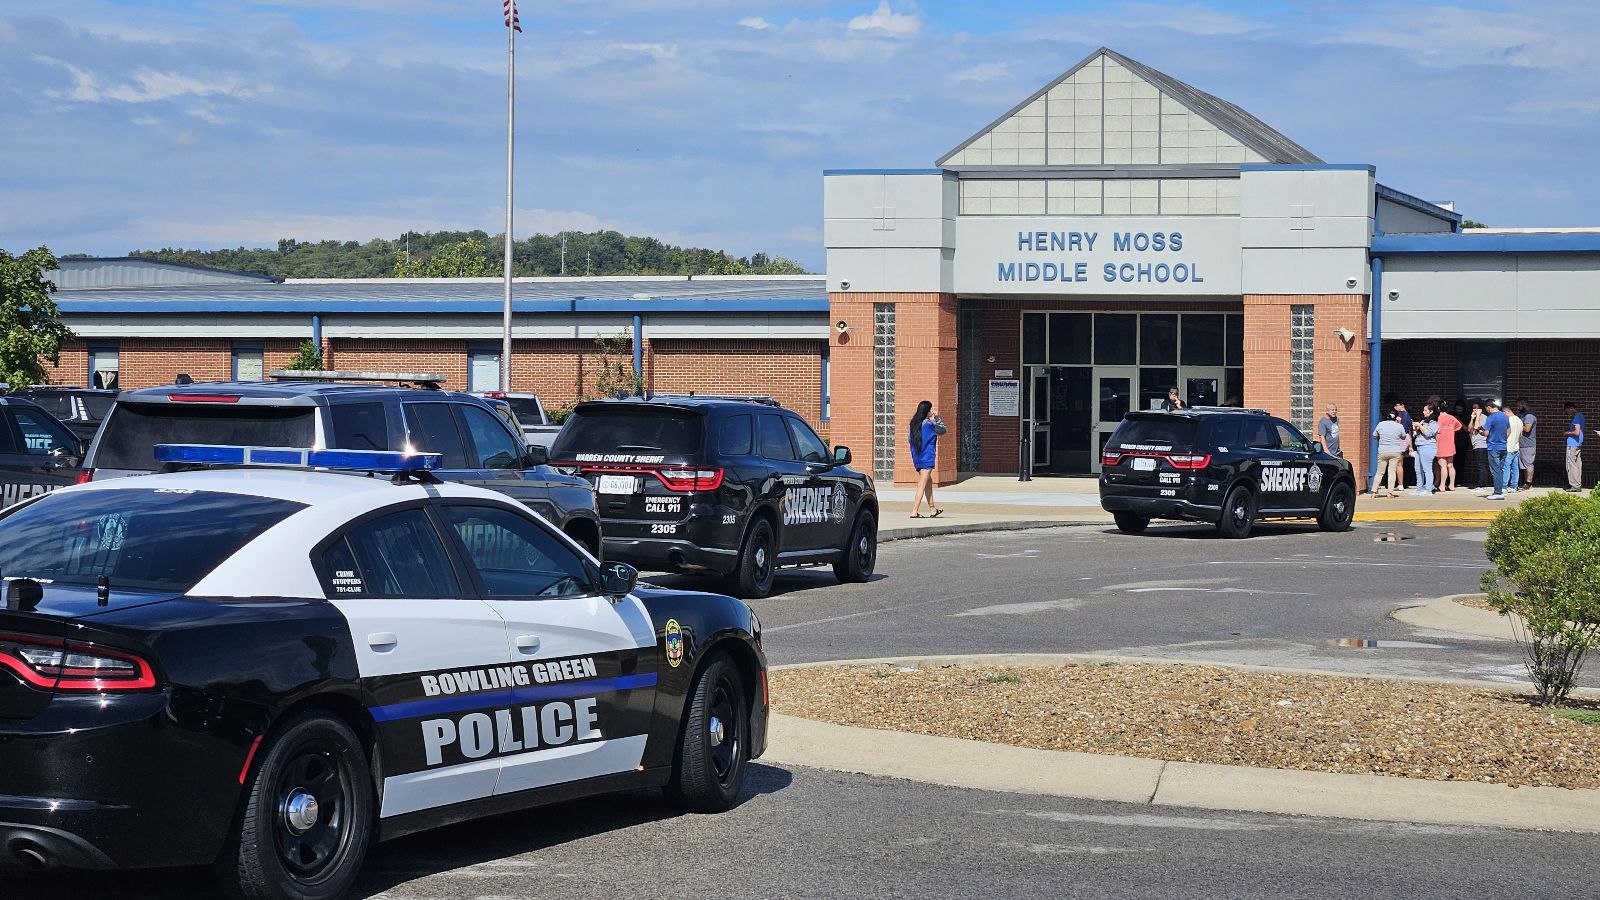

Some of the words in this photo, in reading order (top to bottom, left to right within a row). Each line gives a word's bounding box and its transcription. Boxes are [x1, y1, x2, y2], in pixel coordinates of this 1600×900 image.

[1018, 231, 1098, 251] HENRY
[1113, 231, 1183, 252] MOSS
[998, 262, 1088, 282] MIDDLE
[1103, 262, 1204, 283] SCHOOL
[575, 453, 603, 462] WARREN
[603, 454, 636, 463] COUNTY
[635, 455, 665, 464] SHERIFF
[1261, 466, 1307, 492] SHERIFF
[1160, 489, 1176, 497] 2309
[645, 496, 681, 504] EMERGENCY
[645, 503, 666, 513] CALL
[668, 503, 681, 513] 911
[783, 486, 832, 526] SHERIFF
[722, 514, 736, 525] 2305
[651, 524, 676, 534] 2305
[335, 570, 355, 578] CRIME
[420, 665, 530, 697] BOWLING
[532, 657, 598, 688] GREEN
[420, 697, 602, 766] POLICE
